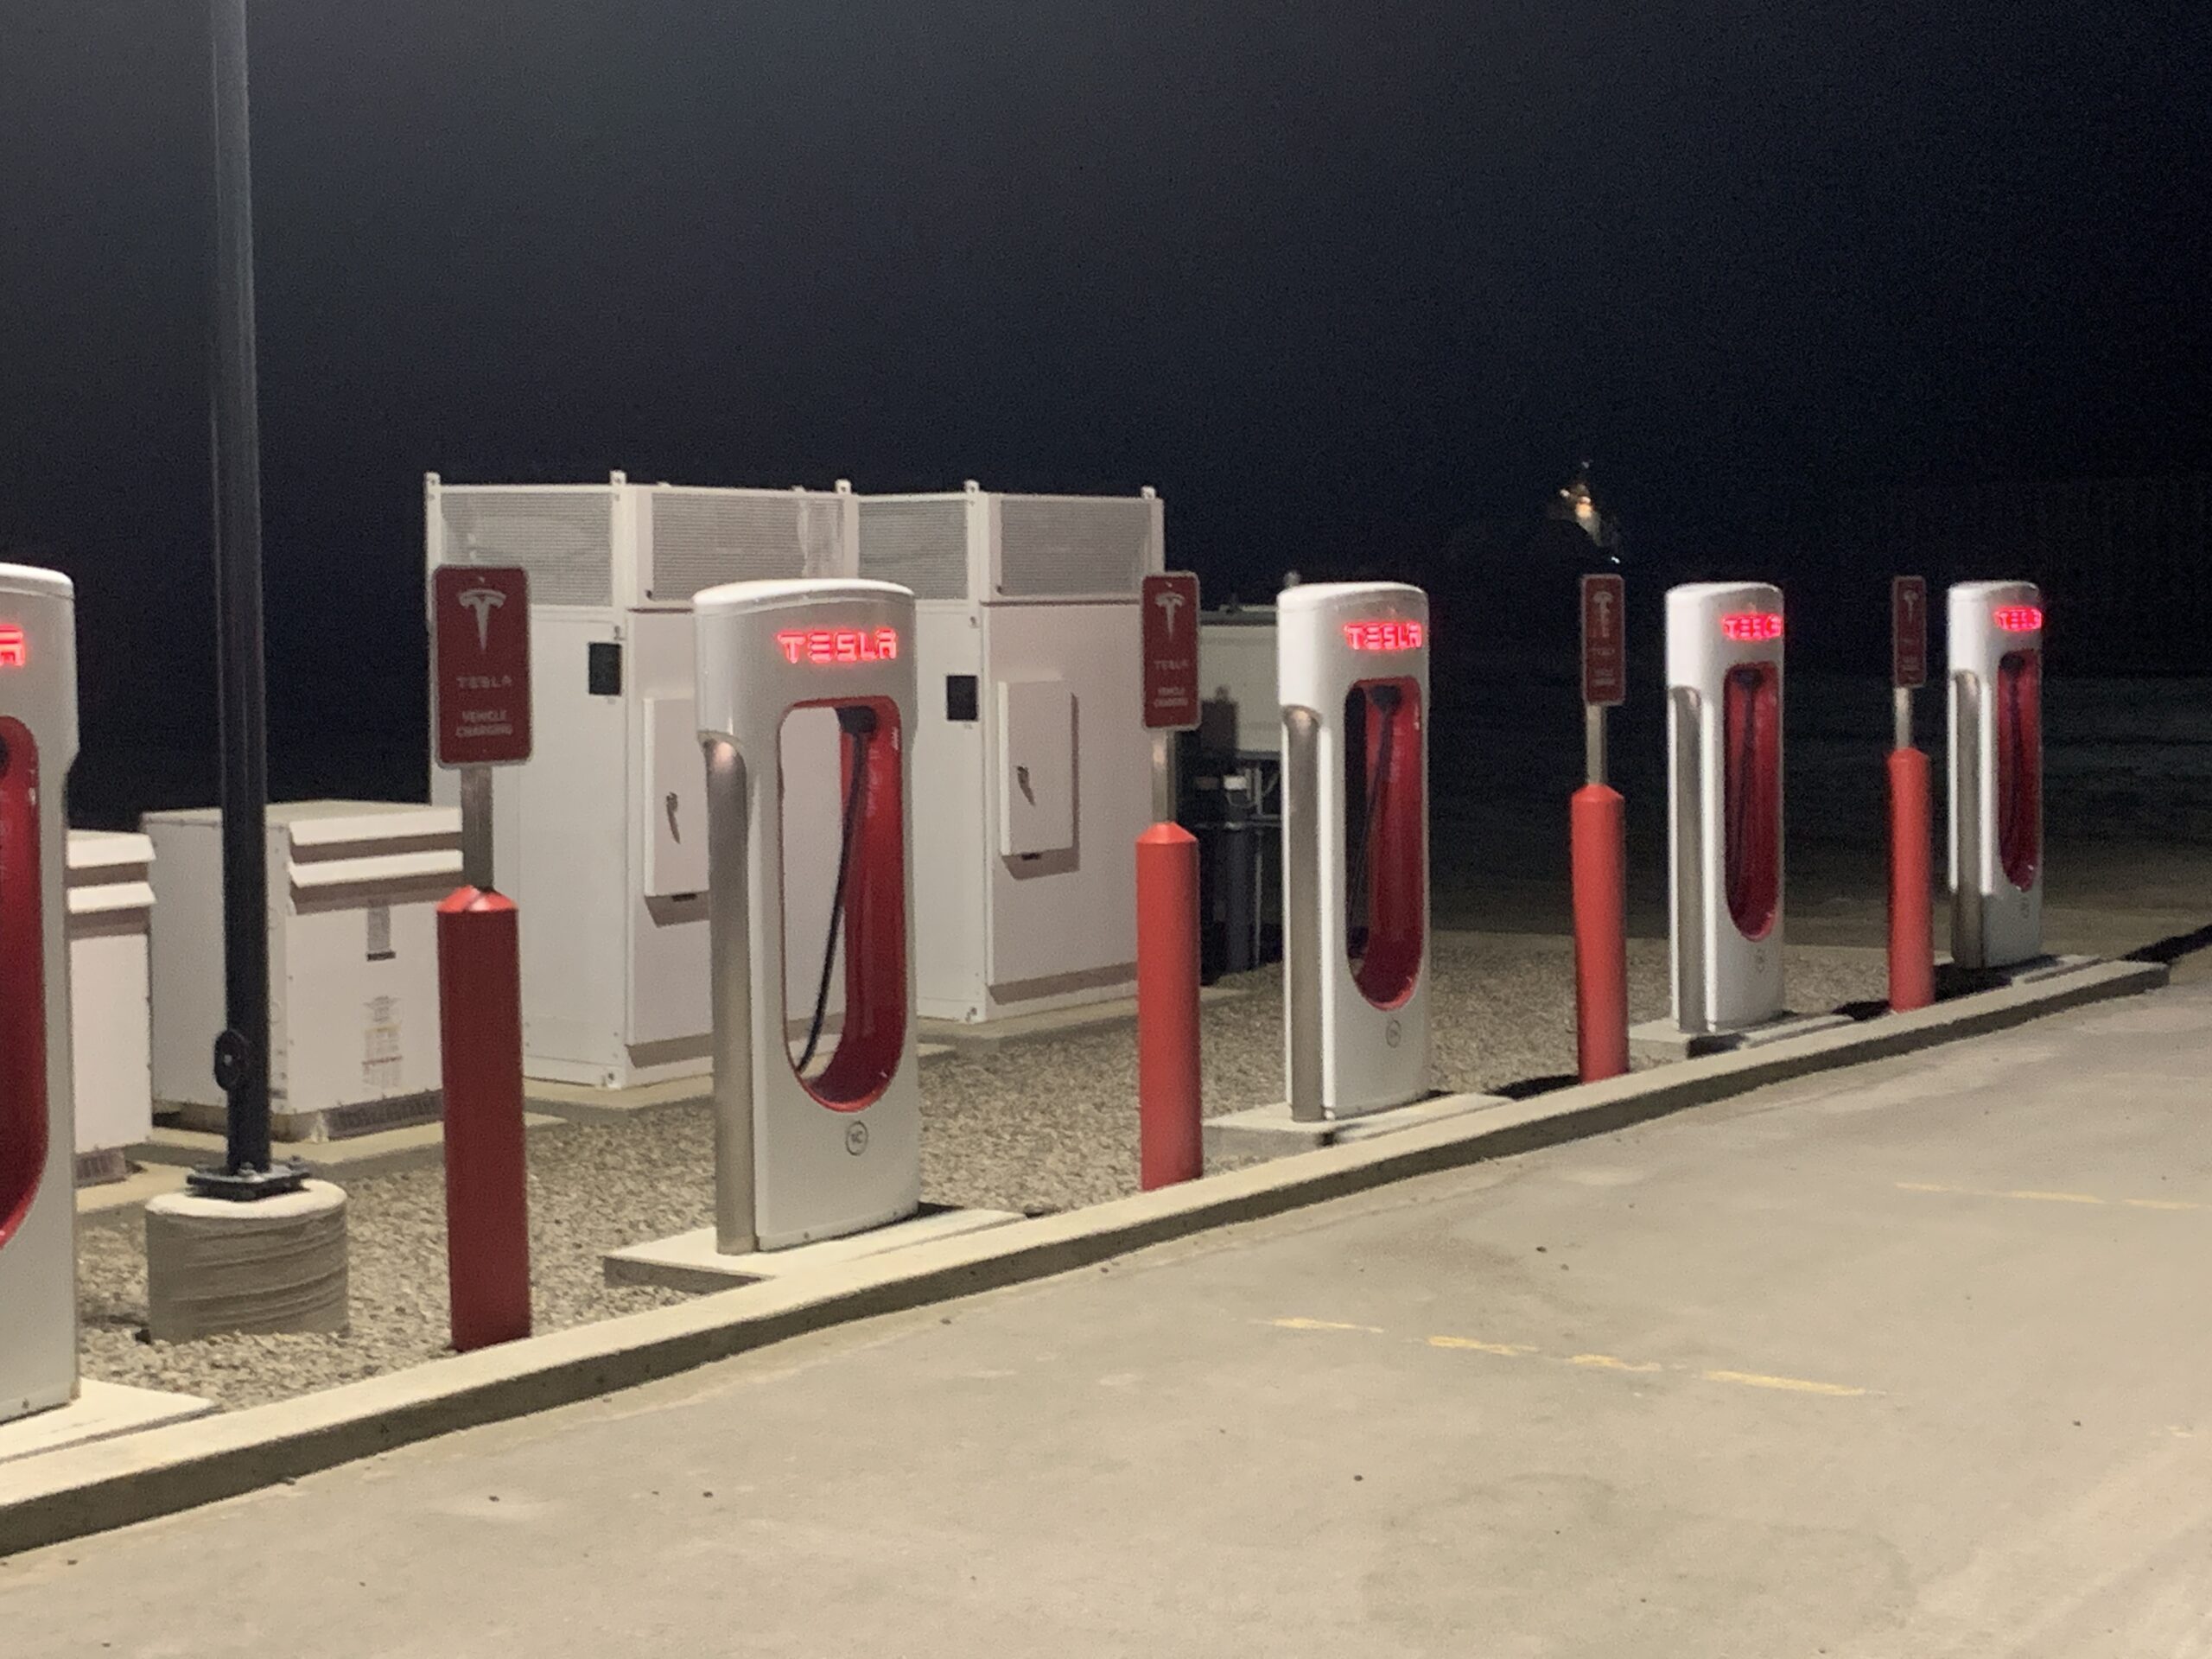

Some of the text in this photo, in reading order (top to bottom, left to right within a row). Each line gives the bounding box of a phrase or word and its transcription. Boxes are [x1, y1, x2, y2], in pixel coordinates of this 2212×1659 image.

[776, 627, 898, 664] TESLA
[1343, 621, 1421, 651] TESLA
[455, 675, 512, 689] TESLA
